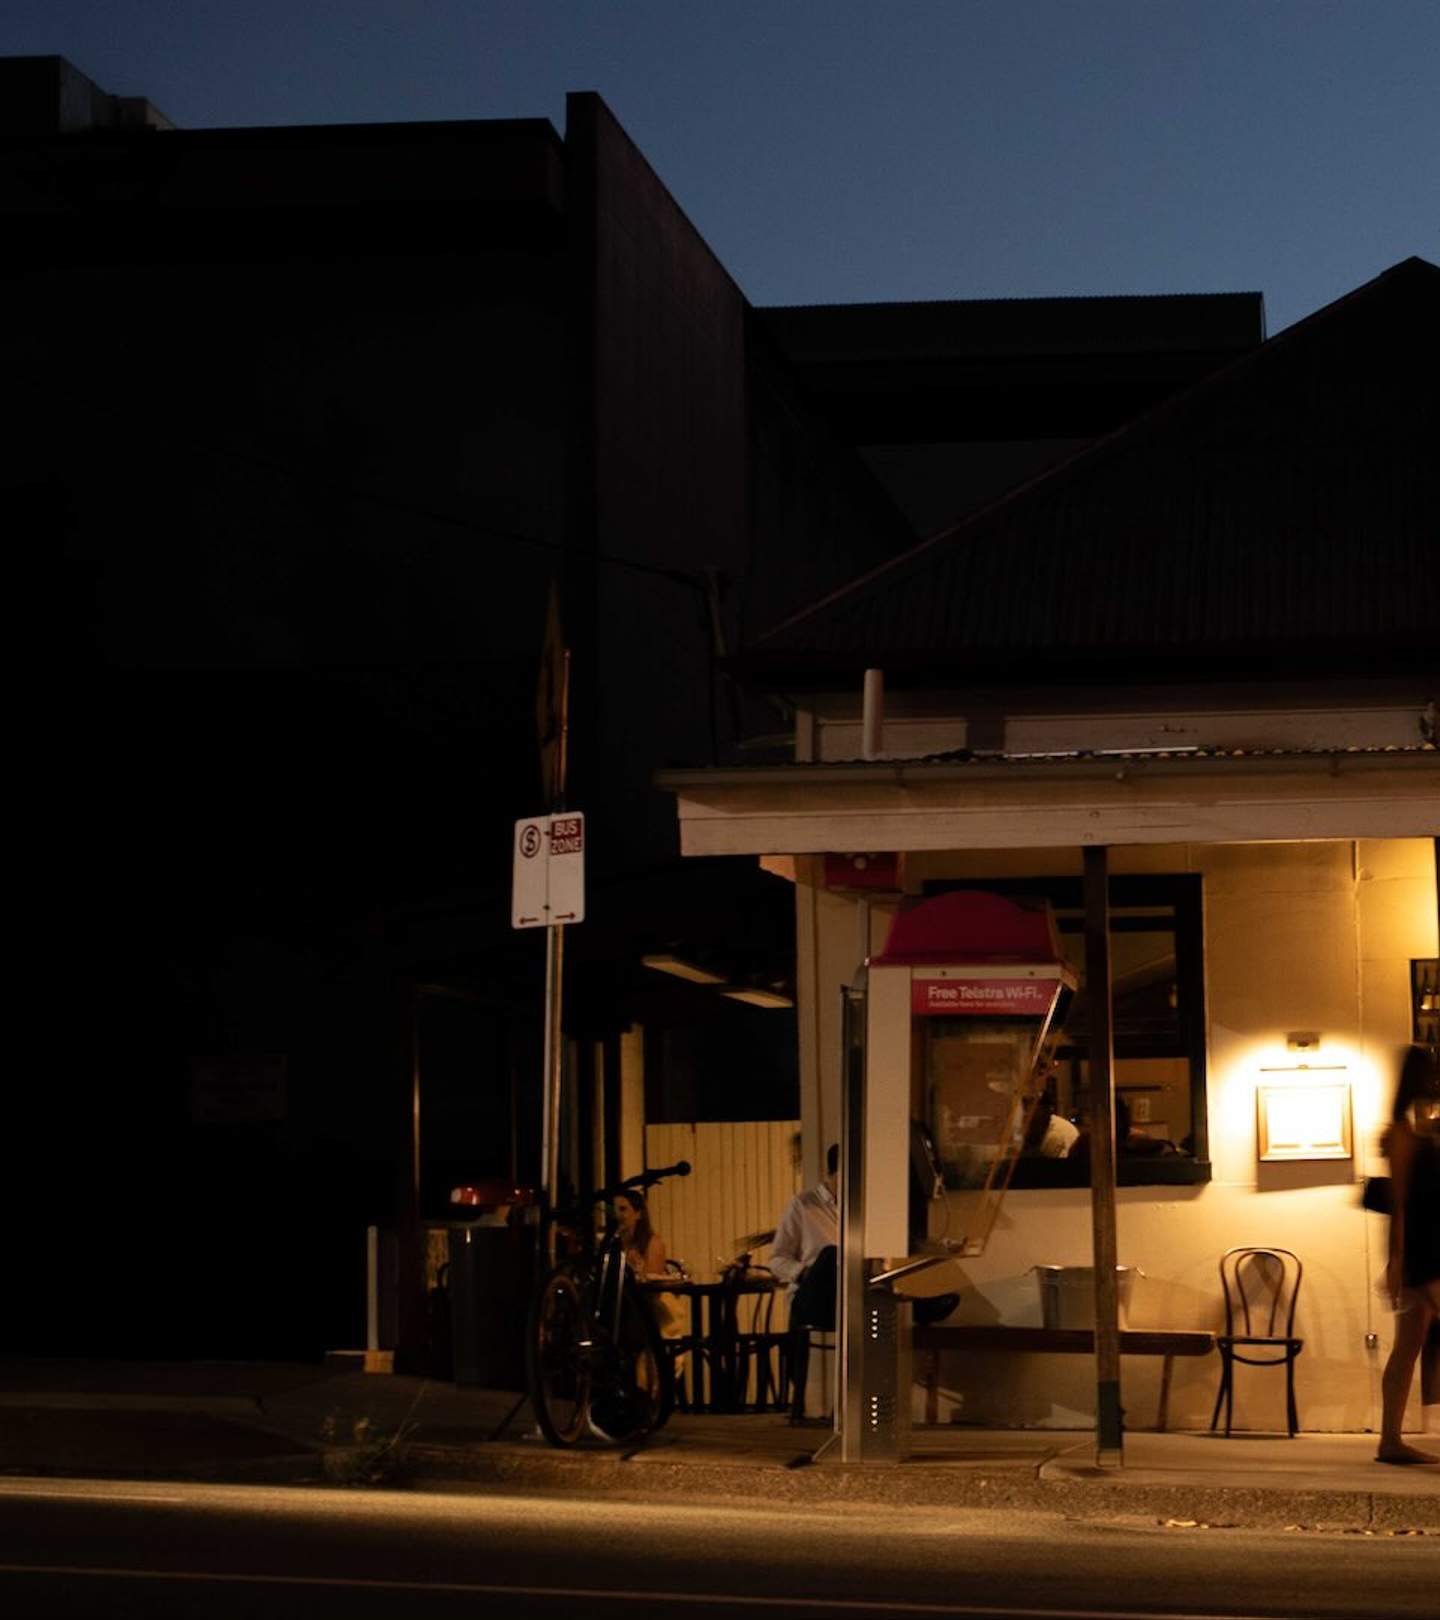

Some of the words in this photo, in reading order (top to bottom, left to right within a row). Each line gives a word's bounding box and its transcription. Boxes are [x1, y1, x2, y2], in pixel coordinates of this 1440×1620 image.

[555, 820, 577, 836] BUS
[551, 837, 581, 854] ZONE
[928, 986, 957, 999] Free
[958, 986, 1004, 999] Telstra
